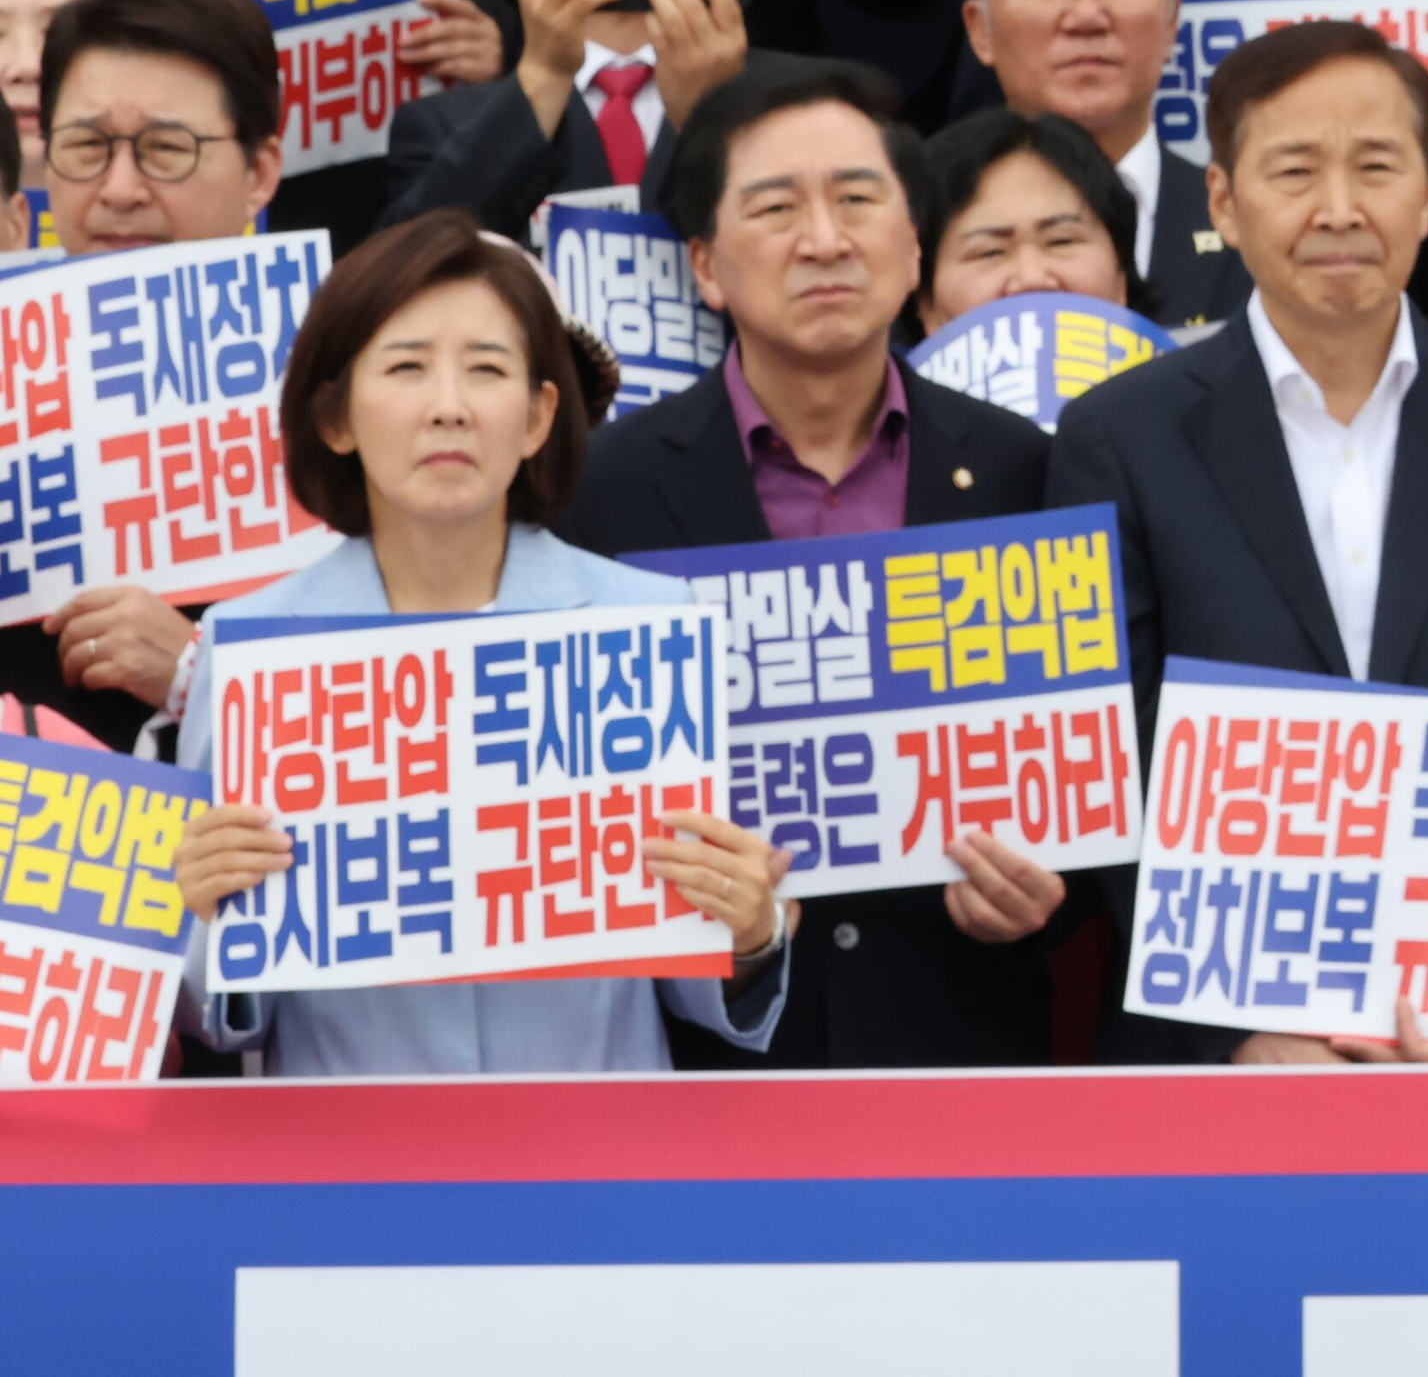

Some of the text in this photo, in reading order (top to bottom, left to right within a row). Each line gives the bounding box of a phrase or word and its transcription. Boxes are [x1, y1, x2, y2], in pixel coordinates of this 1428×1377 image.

[86, 232, 321, 418] 독재정치
[884, 530, 1120, 693] 특검악법
[219, 615, 715, 816] 야당탄압 독재정치
[896, 703, 1129, 858] 거부하라
[1156, 716, 1404, 860] 야당탄압
[1138, 867, 1381, 1014] 정치보복
